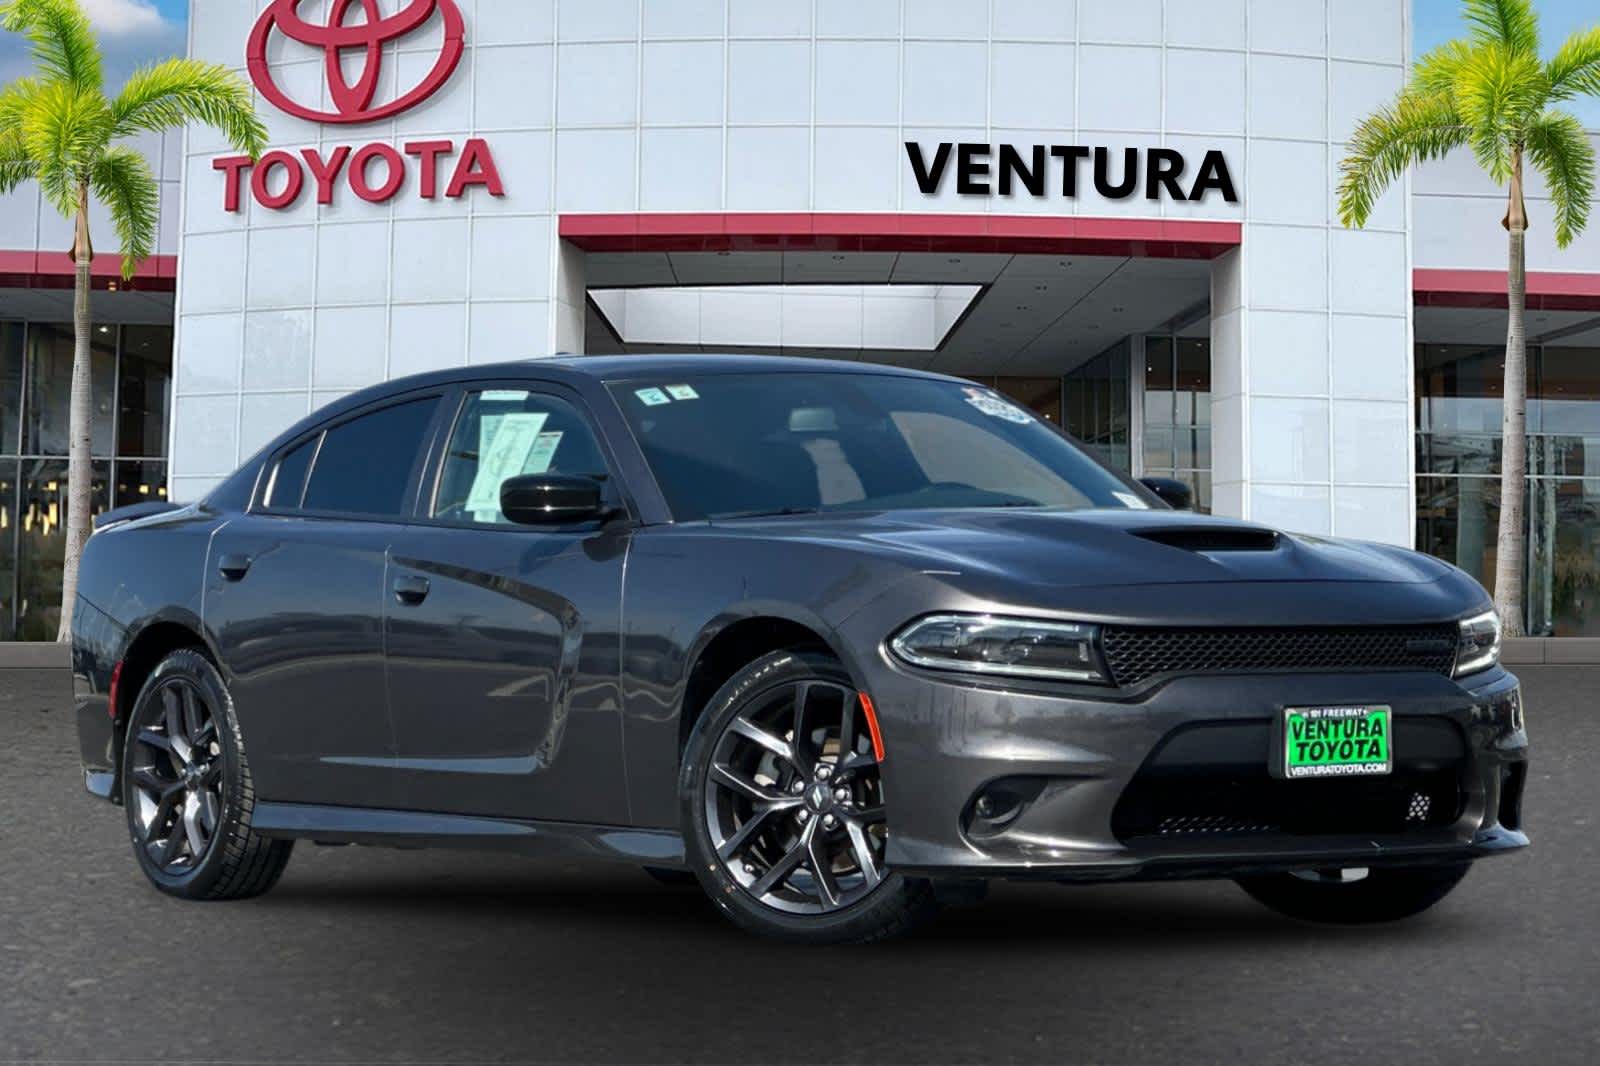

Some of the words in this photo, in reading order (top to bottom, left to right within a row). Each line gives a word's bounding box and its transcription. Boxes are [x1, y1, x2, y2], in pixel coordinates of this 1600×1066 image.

[212, 138, 504, 212] TOYOTA
[904, 141, 1239, 203] VENTURA
[1292, 718, 1383, 740] VENTURA
[1296, 739, 1381, 762] TOYOTA
[1291, 763, 1387, 776] VENTURATOYOTA.COM
